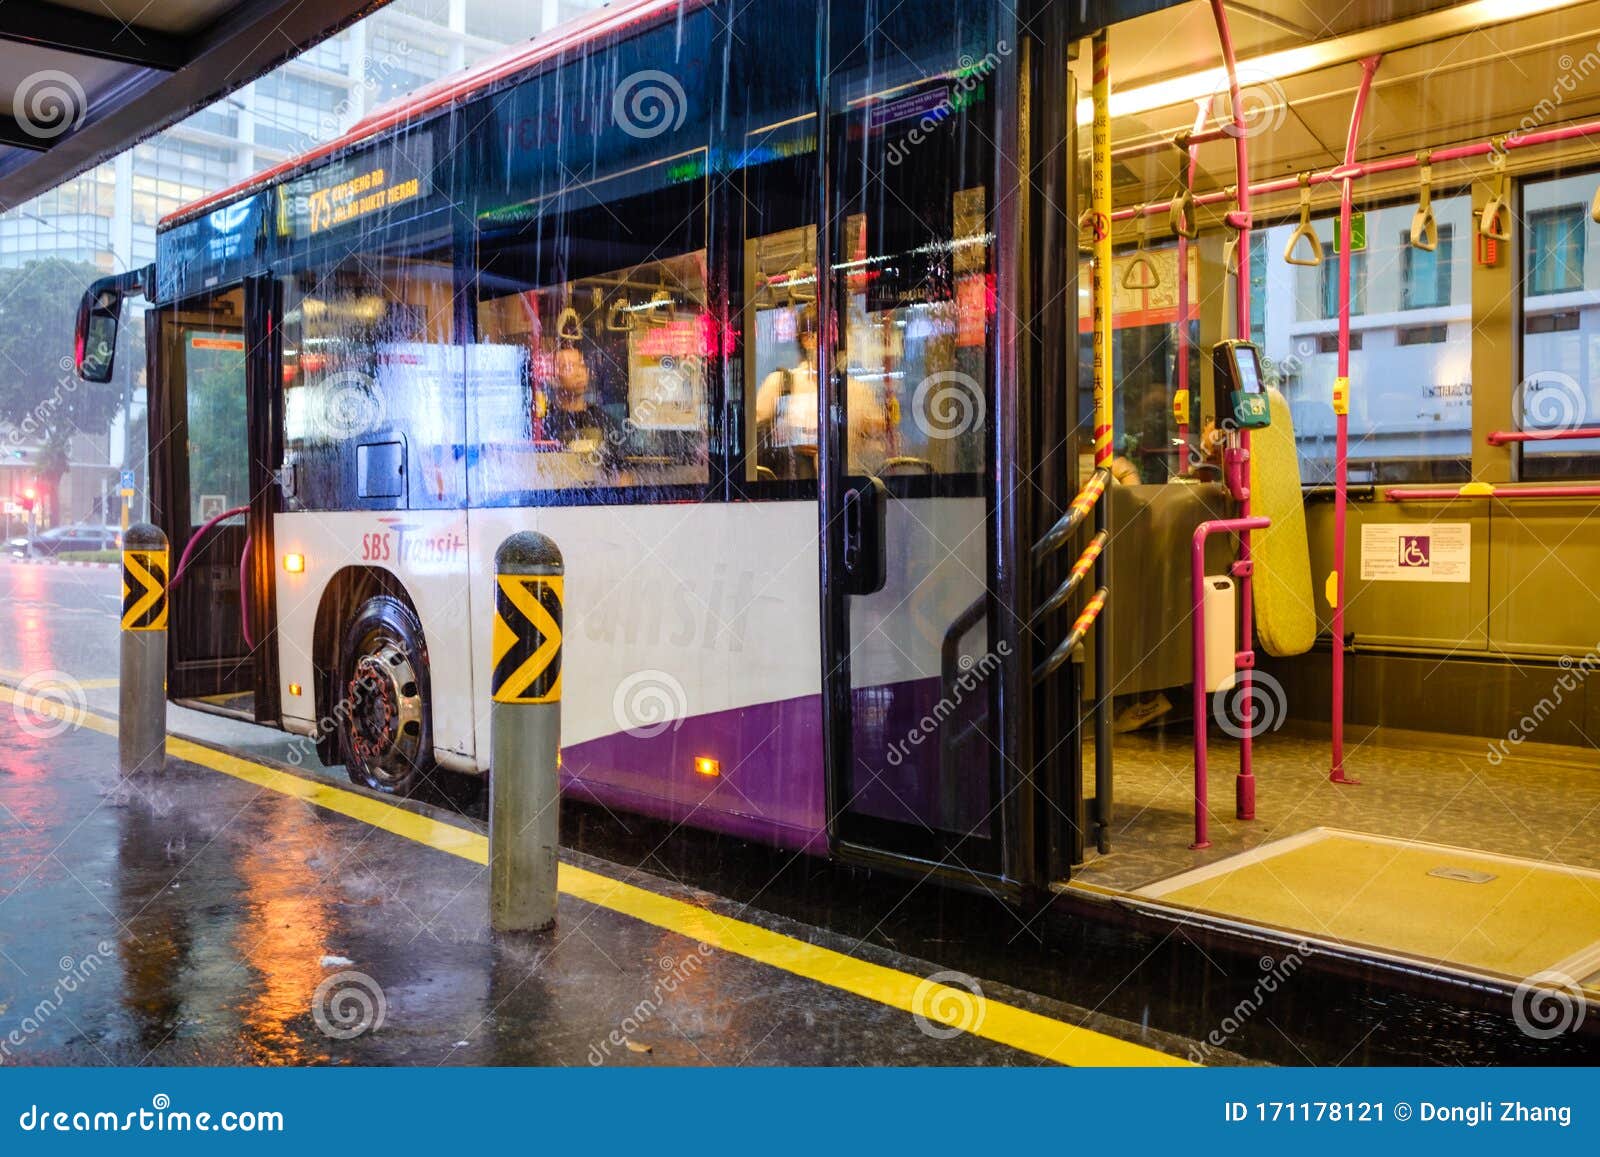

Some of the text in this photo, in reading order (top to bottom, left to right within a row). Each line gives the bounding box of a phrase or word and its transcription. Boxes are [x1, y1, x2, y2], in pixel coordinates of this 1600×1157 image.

[387, 177, 418, 204] MERAH
[362, 524, 465, 566] SBS Transit
